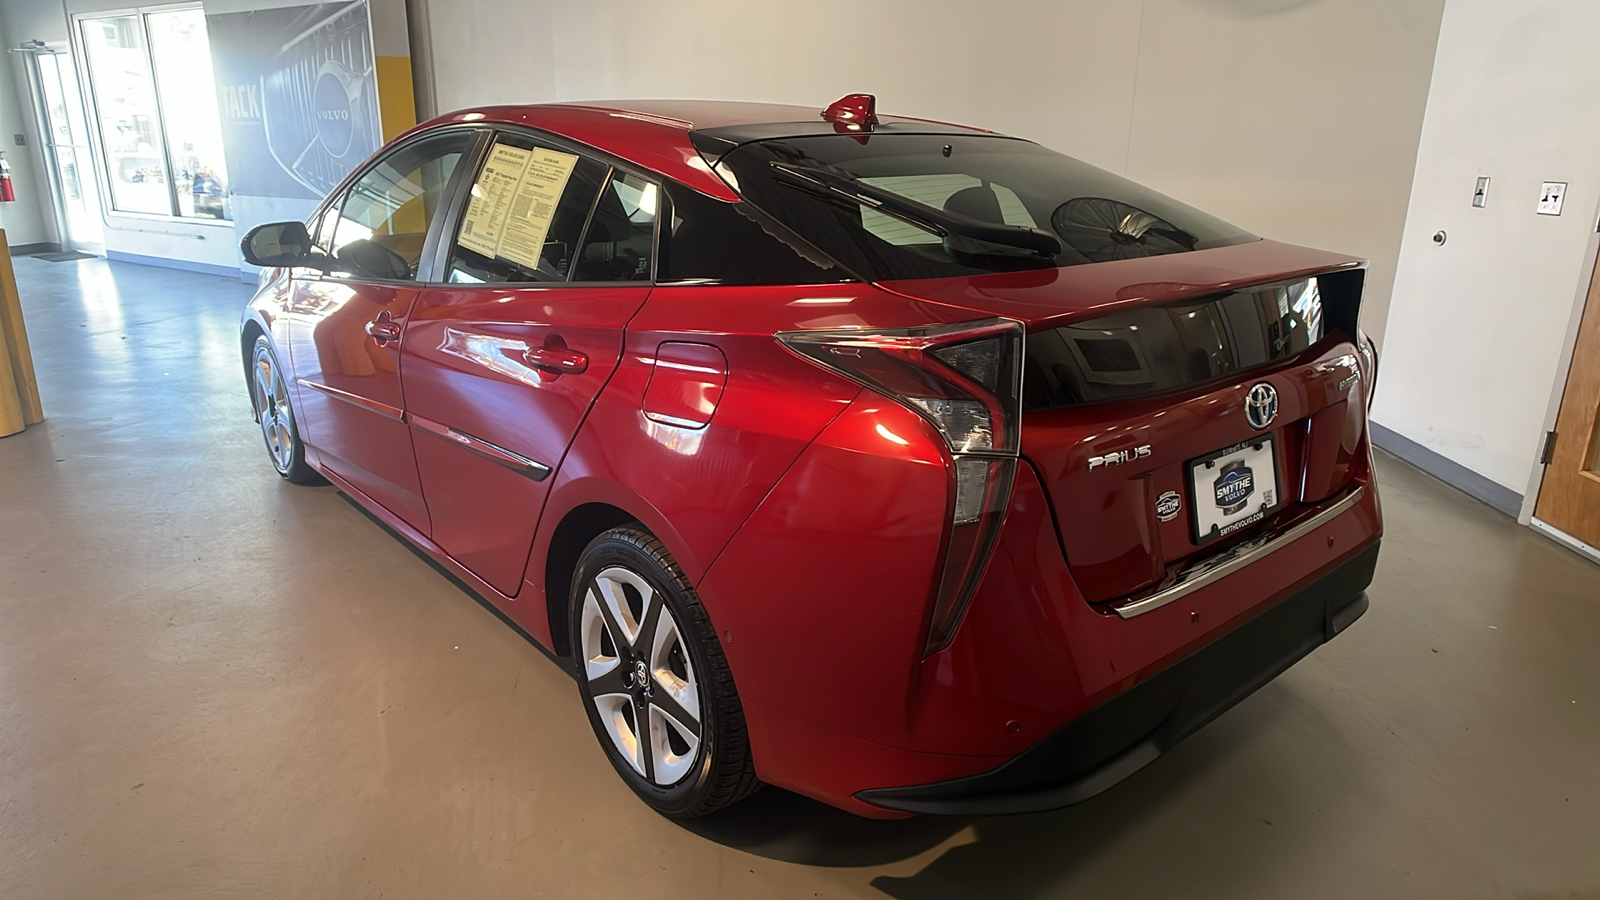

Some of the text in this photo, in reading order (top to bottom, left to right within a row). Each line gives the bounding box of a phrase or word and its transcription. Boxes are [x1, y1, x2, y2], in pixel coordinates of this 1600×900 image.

[316, 109, 349, 120] VOLVO
[1088, 444, 1151, 472] PRIUS
[1217, 477, 1251, 499] SMYTHE
[1225, 488, 1246, 502] VOLVO
[1158, 501, 1179, 513] SMYTHE
[1220, 511, 1264, 537] SMYTHEVOLVO.COM
